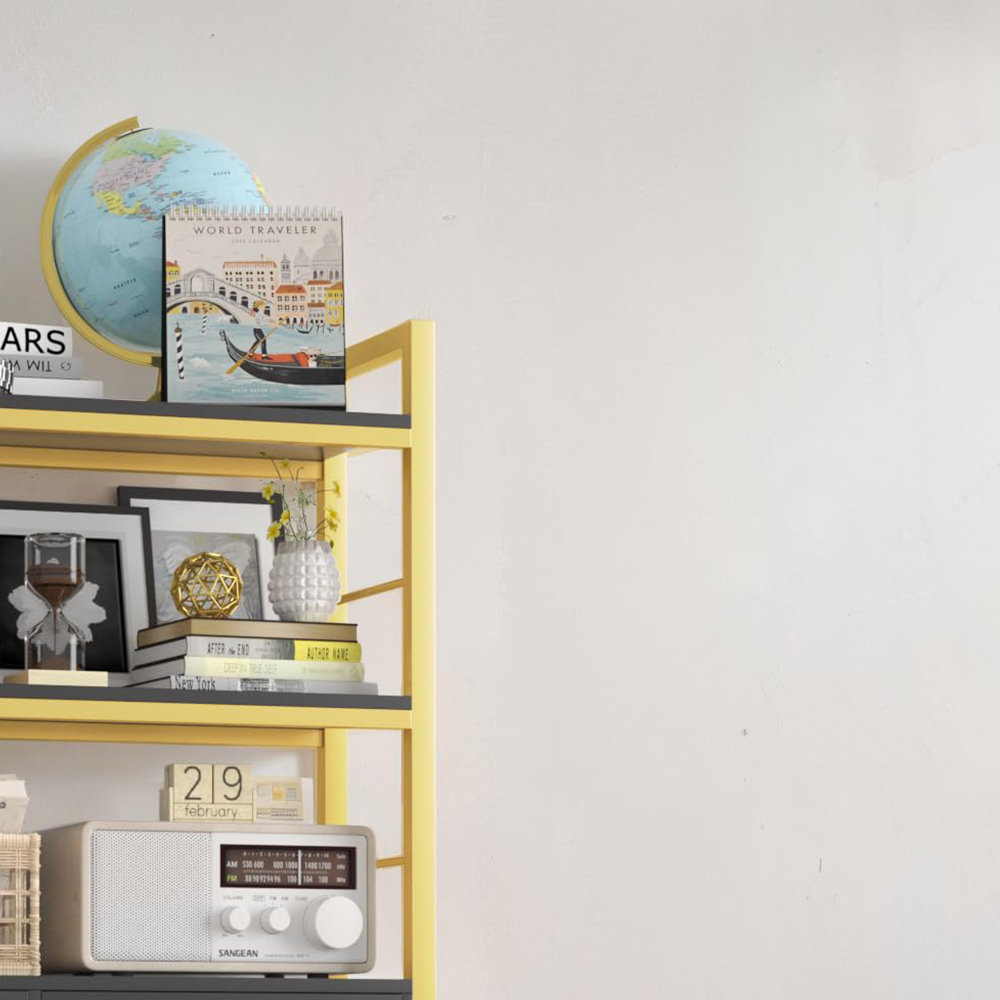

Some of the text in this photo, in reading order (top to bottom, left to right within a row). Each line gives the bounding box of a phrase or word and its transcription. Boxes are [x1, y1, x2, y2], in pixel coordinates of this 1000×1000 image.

[194, 226, 317, 235] WORLD TRAVELER
[27, 359, 53, 372] TIM
[207, 643, 225, 654] AFTER
[238, 644, 250, 655] END
[307, 647, 349, 660] AUTHOR NAME
[175, 676, 216, 691] New York
[184, 804, 238, 819] february
[219, 949, 258, 957] SANGEAN
